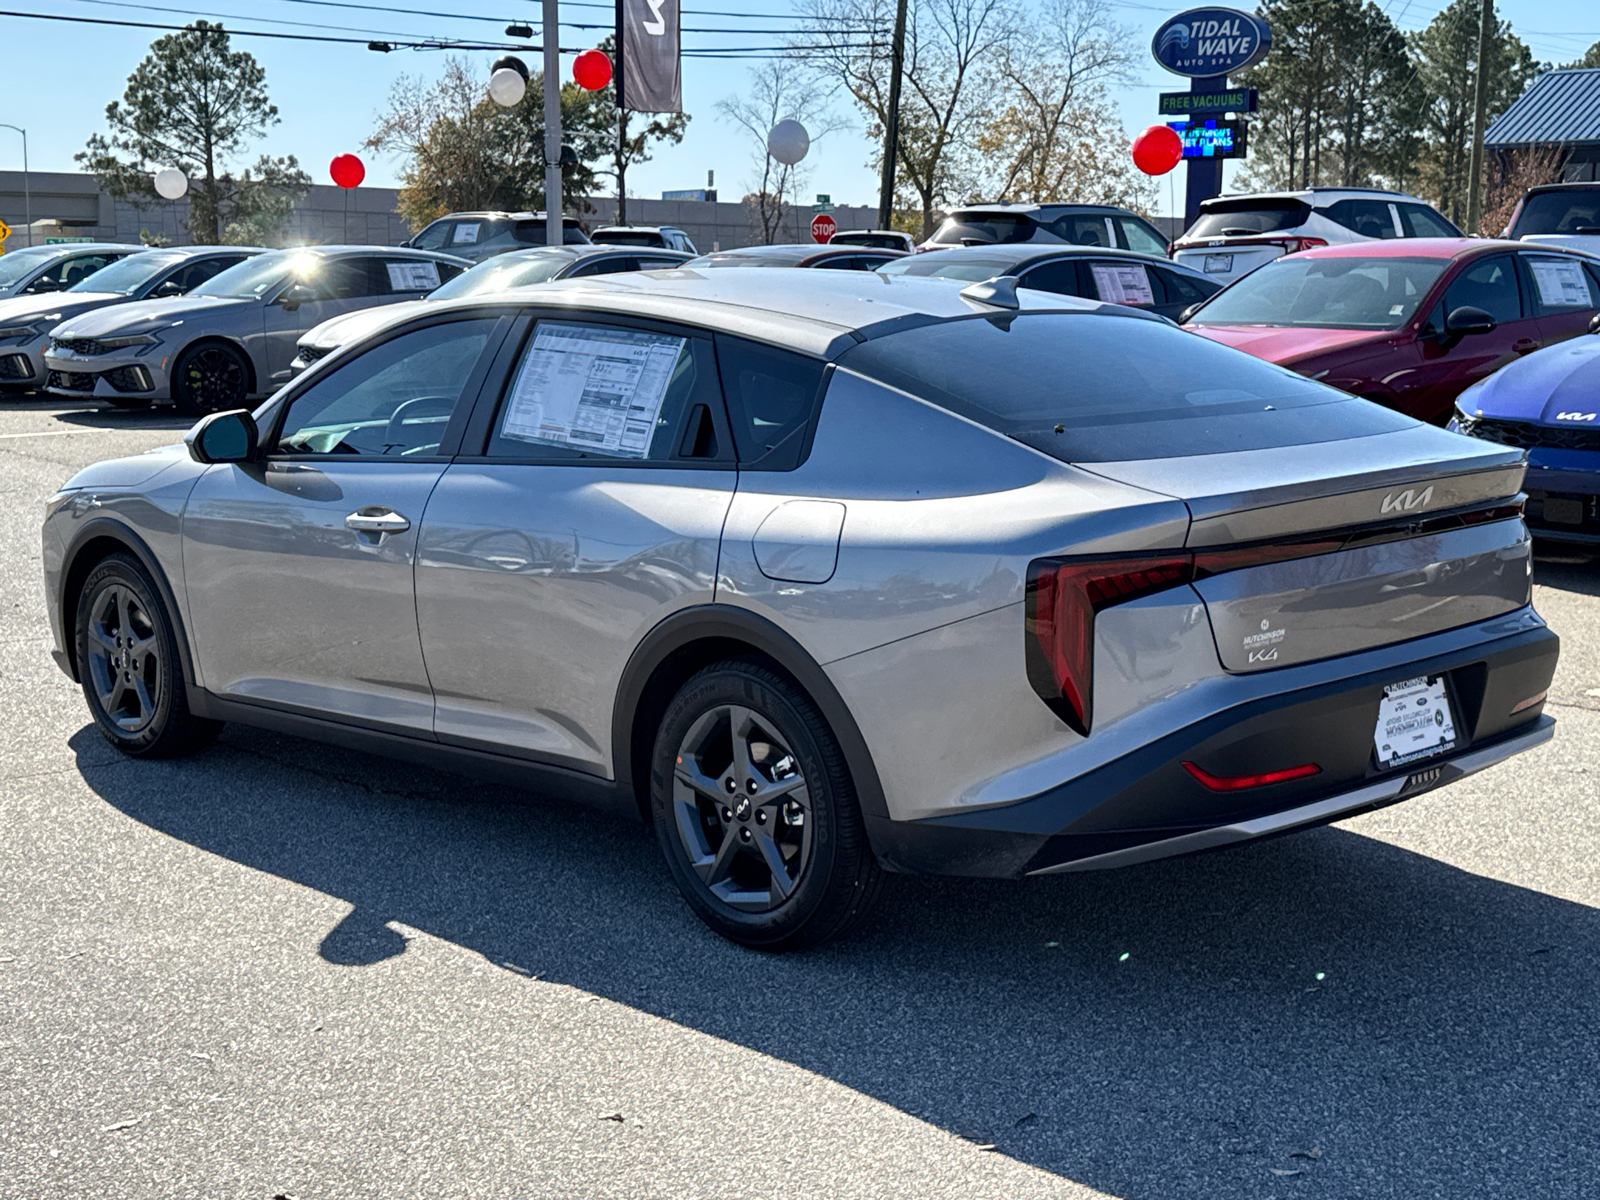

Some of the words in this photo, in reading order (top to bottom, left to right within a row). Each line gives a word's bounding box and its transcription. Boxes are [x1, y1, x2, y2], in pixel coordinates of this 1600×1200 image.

[1190, 19, 1241, 38] TIDAL
[1197, 37, 1251, 56] WAVE
[1176, 59, 1204, 67] AUTO
[1162, 96, 1190, 109] FREE
[1192, 93, 1244, 108] VACUUMS
[812, 223, 835, 236] STOP
[1243, 628, 1286, 645] HUTCHINSON
[1248, 647, 1278, 663] K4
[806, 756, 828, 844] KUMHO
